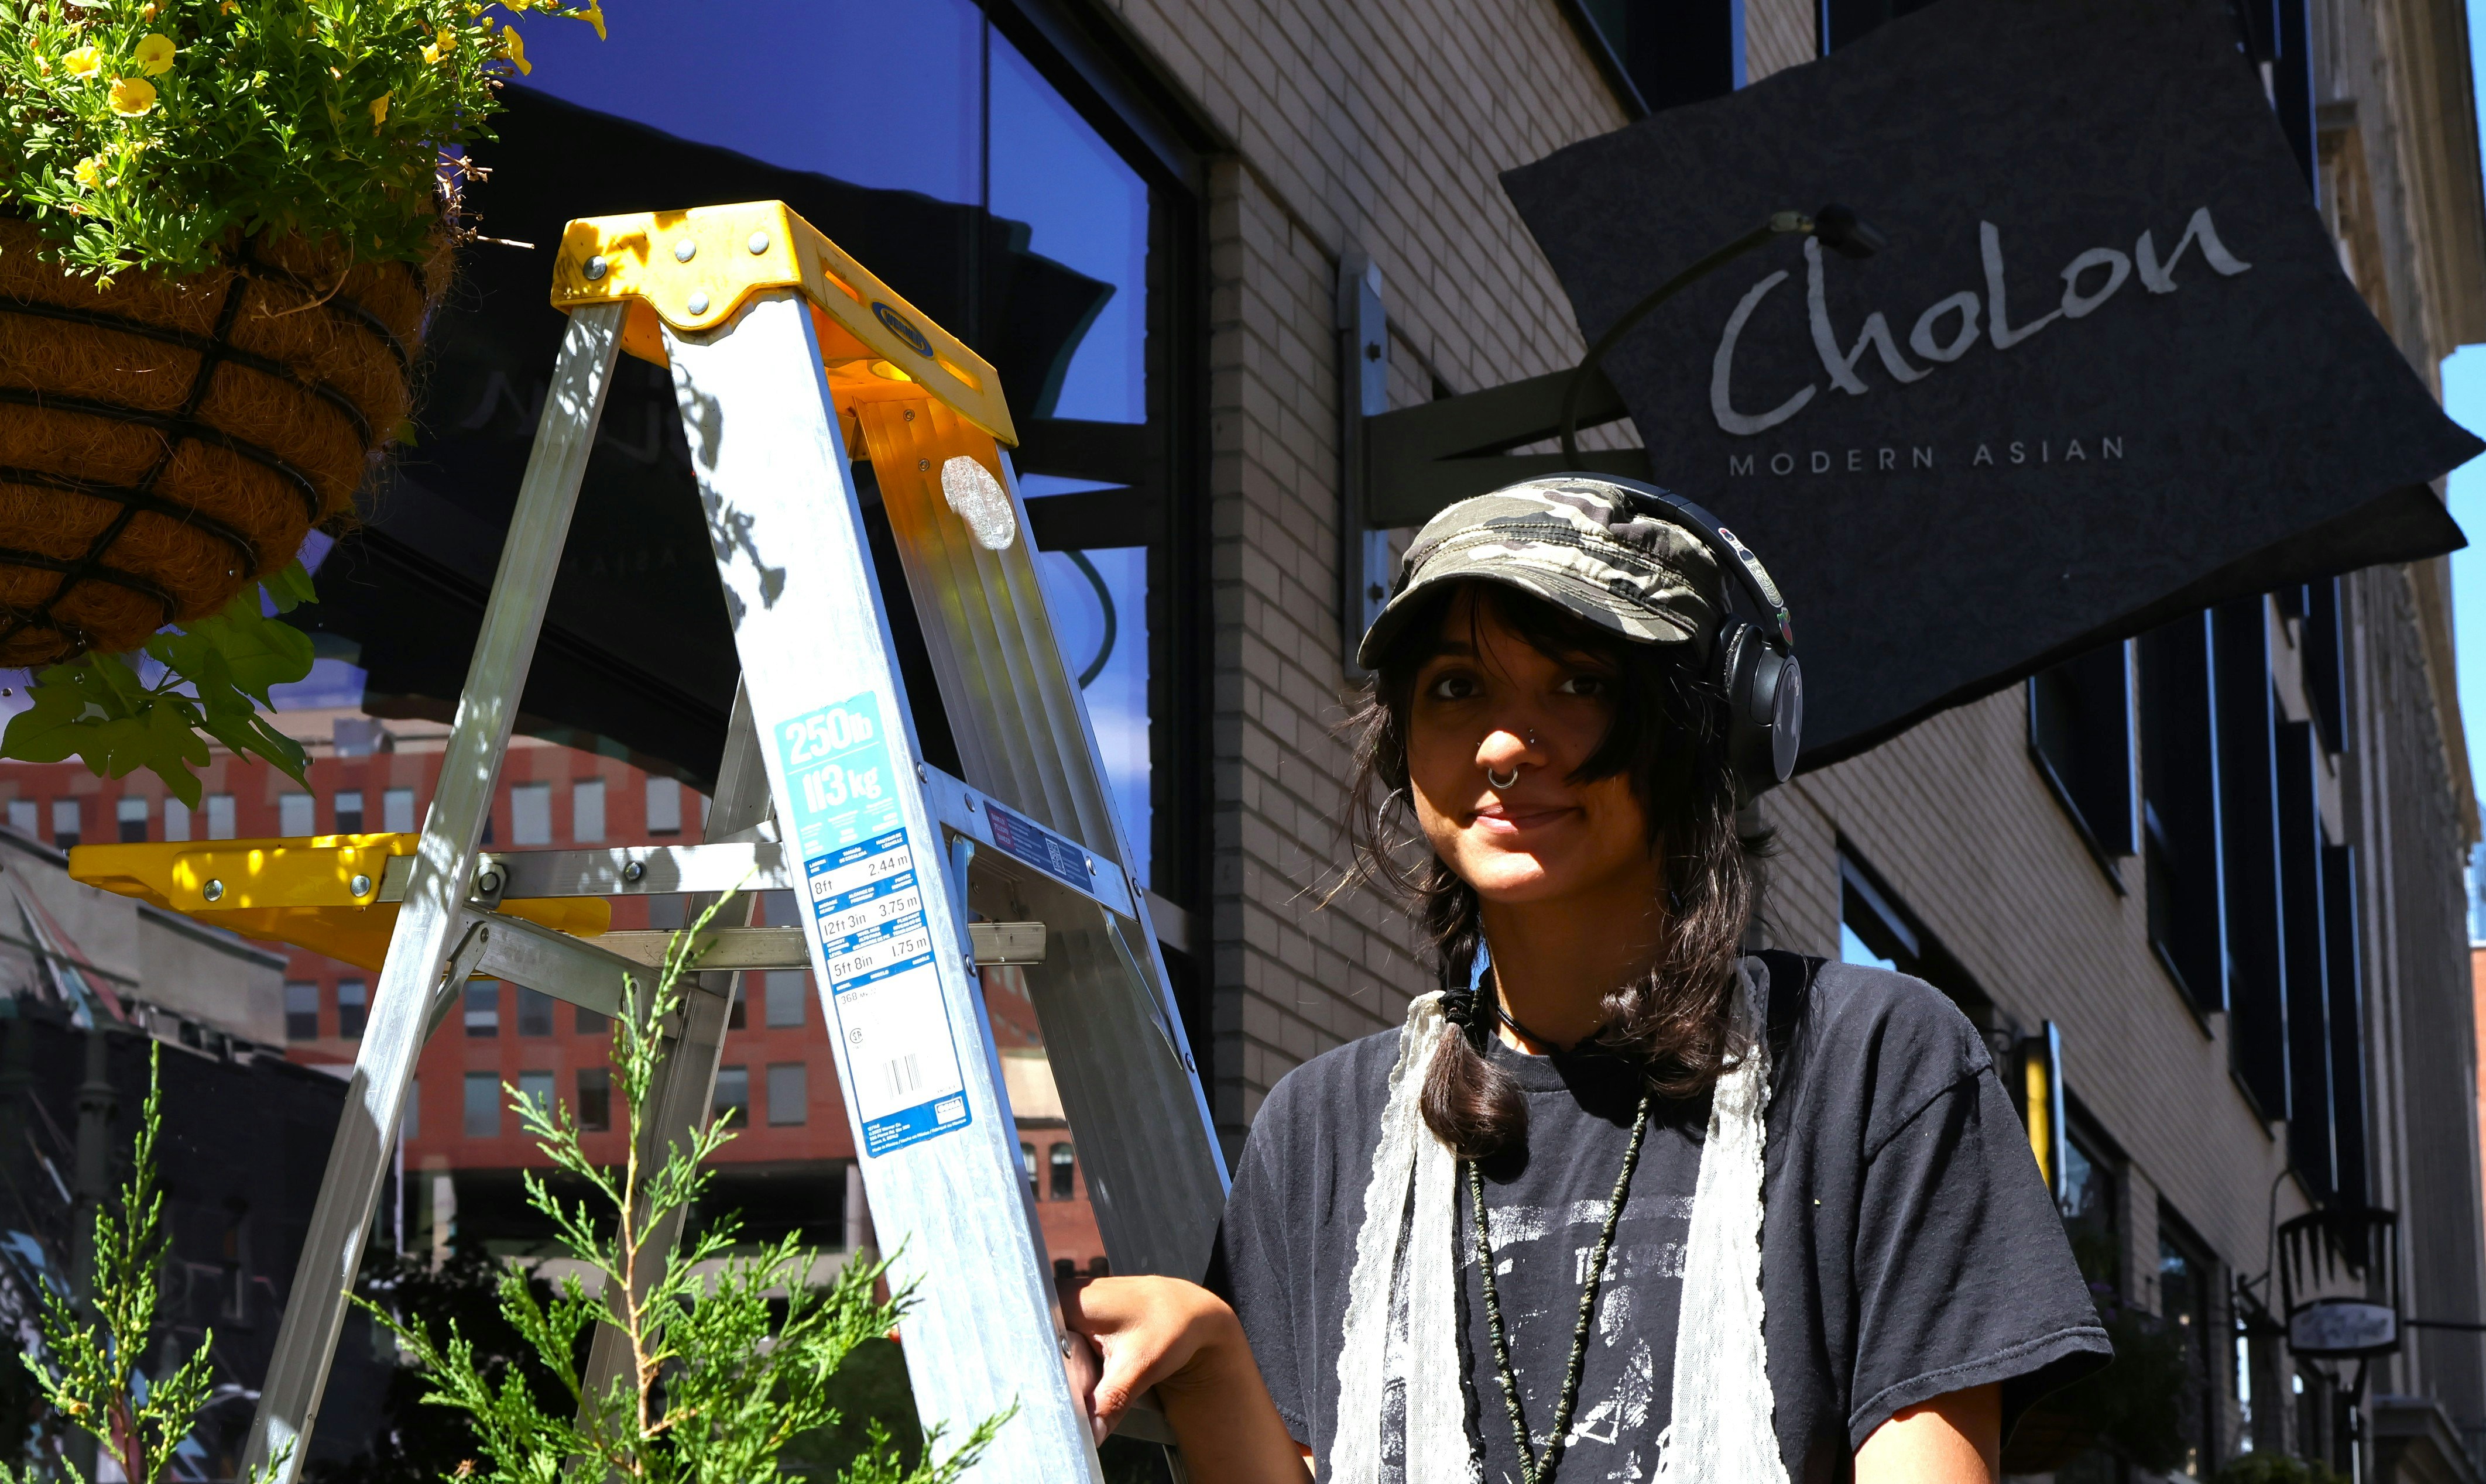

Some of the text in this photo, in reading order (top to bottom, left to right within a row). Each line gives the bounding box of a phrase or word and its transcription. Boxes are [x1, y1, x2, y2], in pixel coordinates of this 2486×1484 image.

[1730, 436, 2124, 476] MODERN ASIAN
[802, 764, 847, 815] 113
[848, 767, 882, 799] kg
[897, 855, 908, 866] m
[815, 880, 832, 895] 8ft
[907, 896, 918, 908] m
[824, 914, 867, 936] 12ft 3in
[916, 937, 927, 949] m
[834, 956, 873, 977] 5ft 8in
[841, 992, 858, 1004] 368
